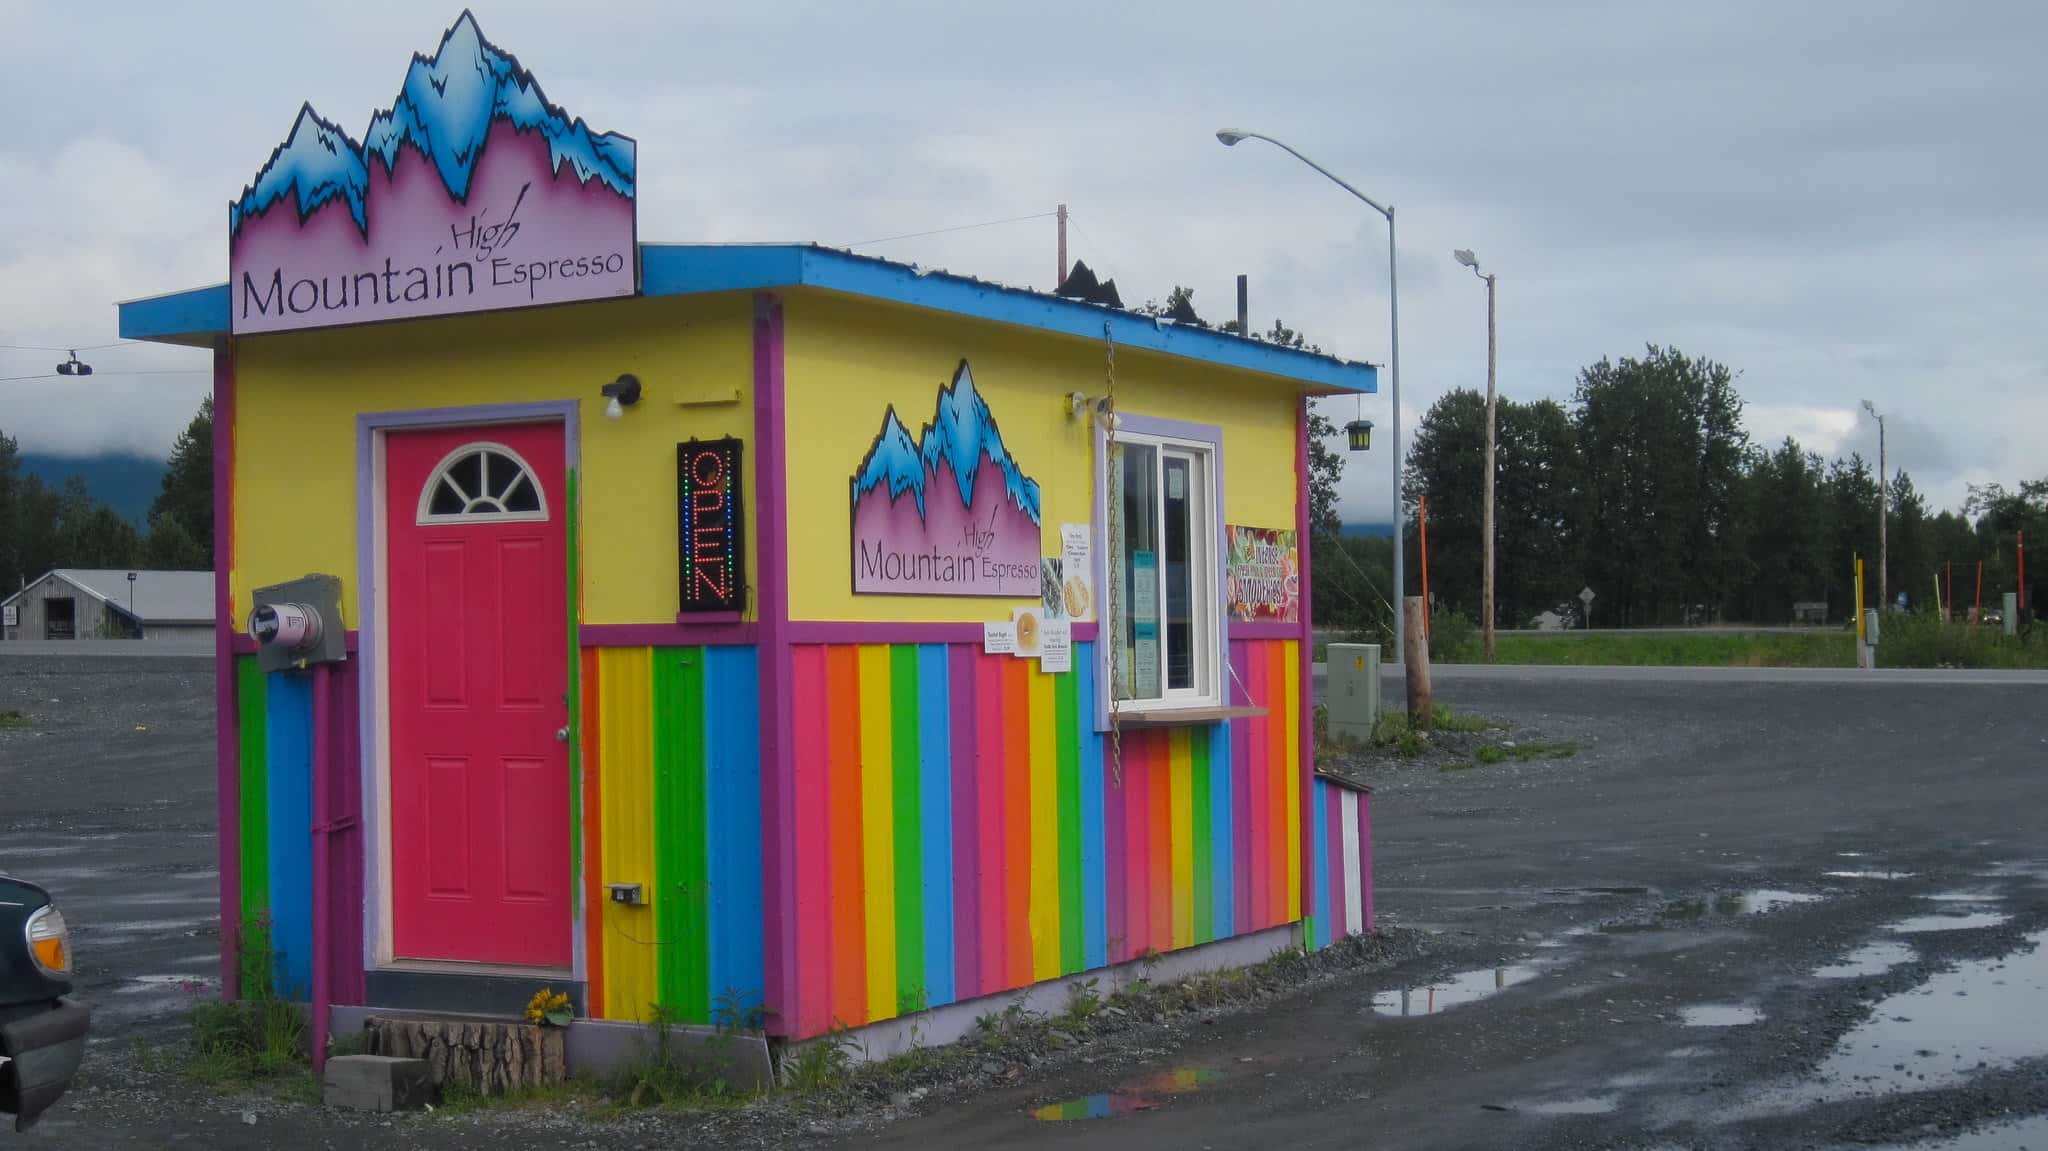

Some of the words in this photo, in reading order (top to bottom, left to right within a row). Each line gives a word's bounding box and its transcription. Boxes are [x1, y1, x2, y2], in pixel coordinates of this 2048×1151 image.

[242, 245, 474, 319] Mountain
[451, 182, 531, 263] High
[491, 252, 624, 300] Espresso
[692, 451, 725, 600] OPEN
[860, 539, 975, 583] Mountain
[963, 503, 998, 559] High
[982, 556, 1038, 592] Espresso
